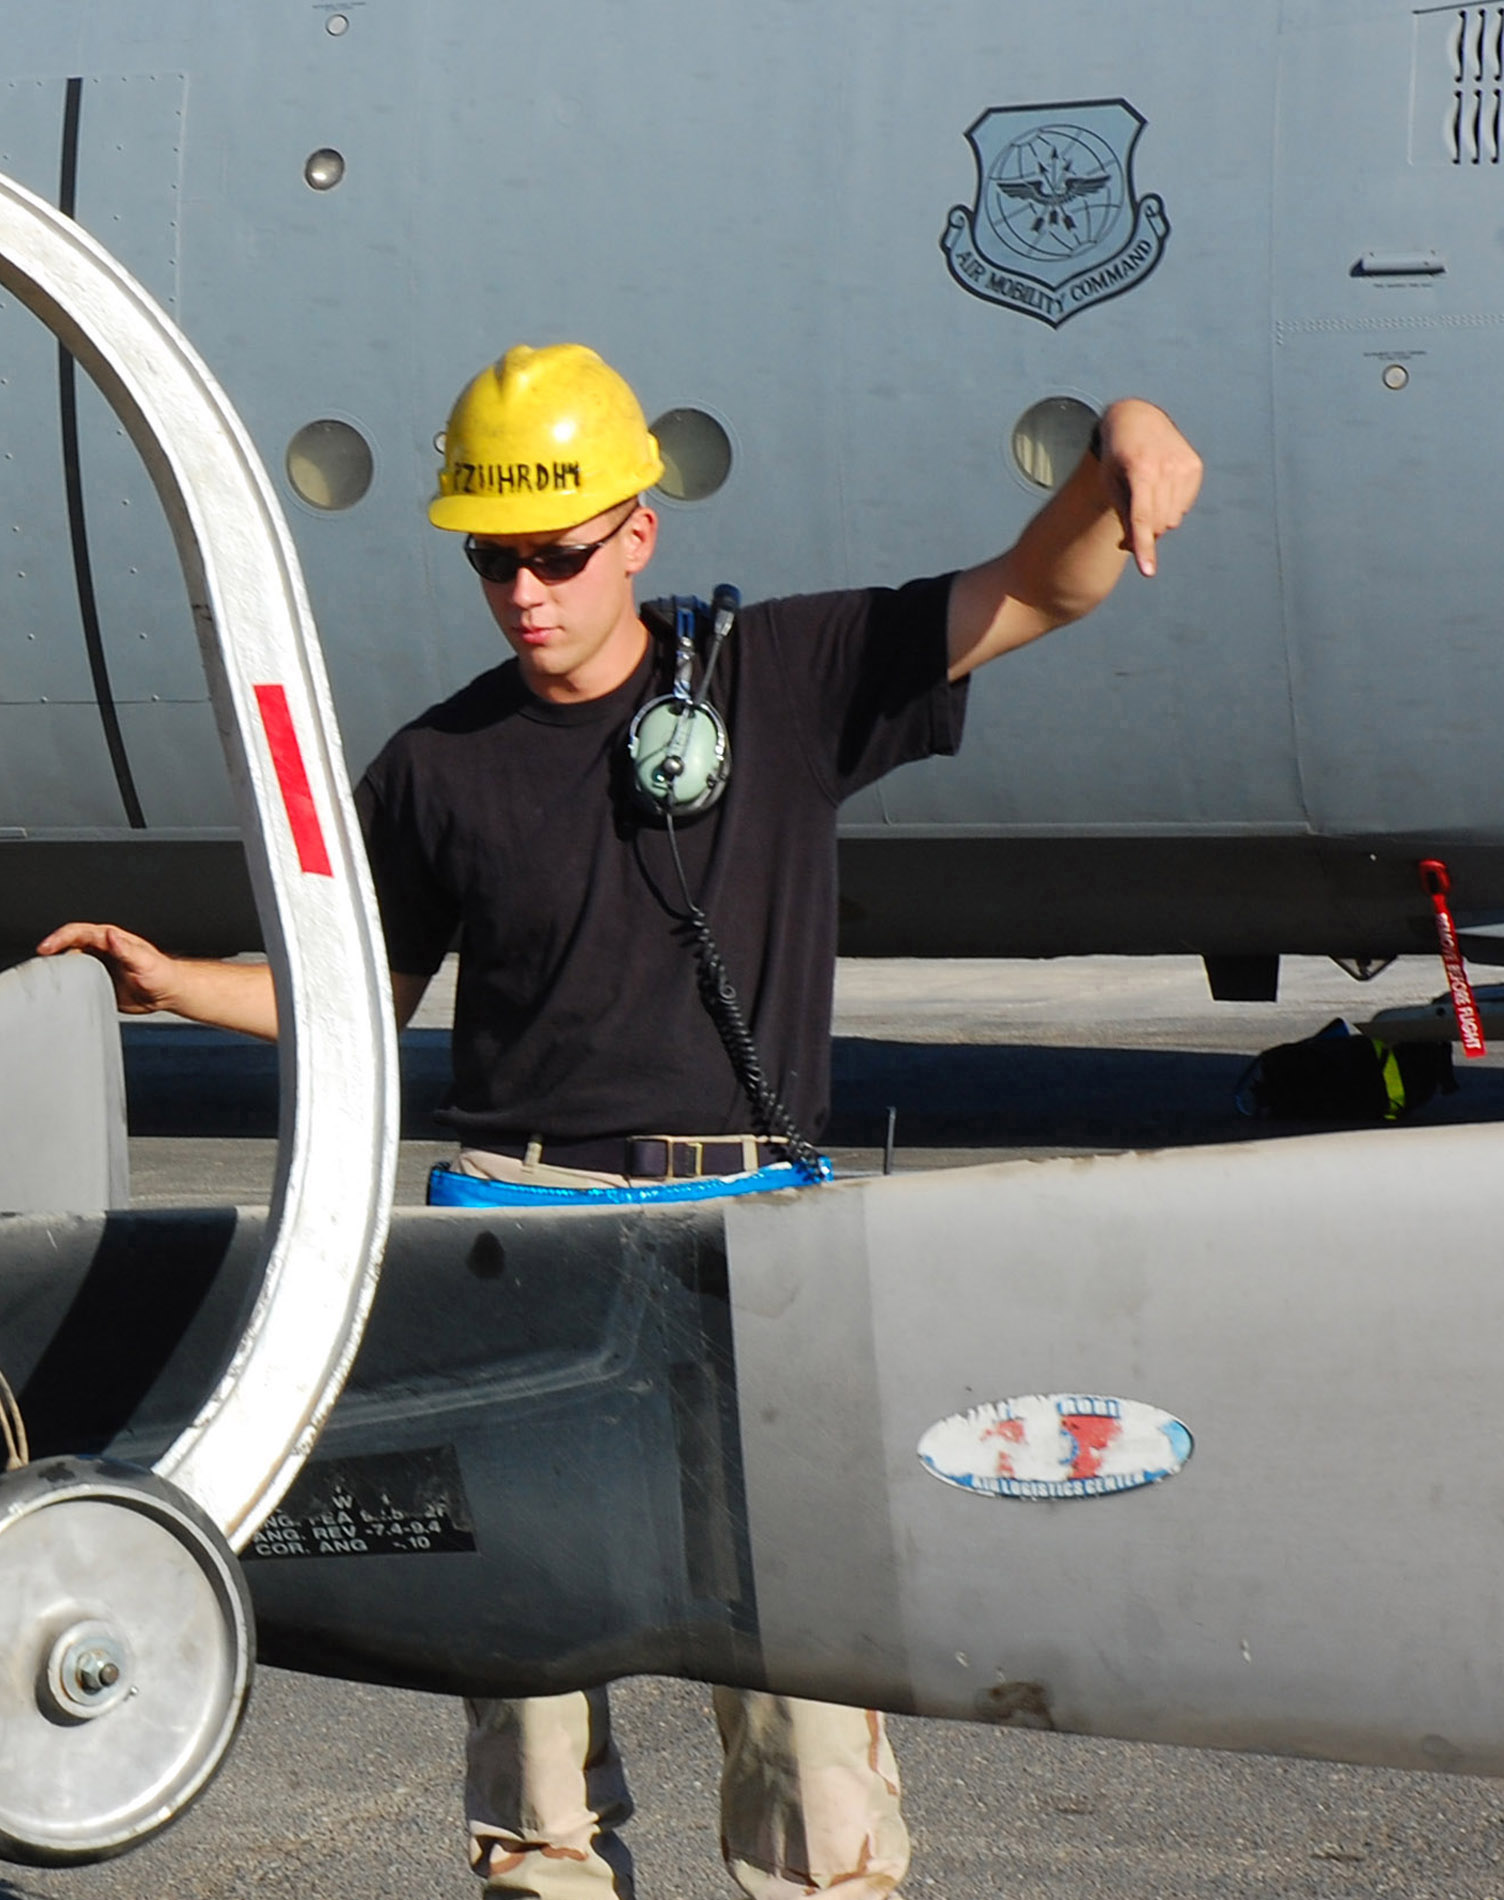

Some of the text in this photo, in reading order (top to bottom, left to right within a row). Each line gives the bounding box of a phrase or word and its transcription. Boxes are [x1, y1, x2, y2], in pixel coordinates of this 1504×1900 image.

[955, 239, 1153, 316] AIR MOBILITY COMMAND
[1457, 1006, 1482, 1049] FLIGHT
[999, 1478, 1085, 1498] LOGISTICS
[261, 1509, 302, 1530] NG.
[312, 1524, 357, 1541] REV
[319, 1537, 369, 1554] ANG
